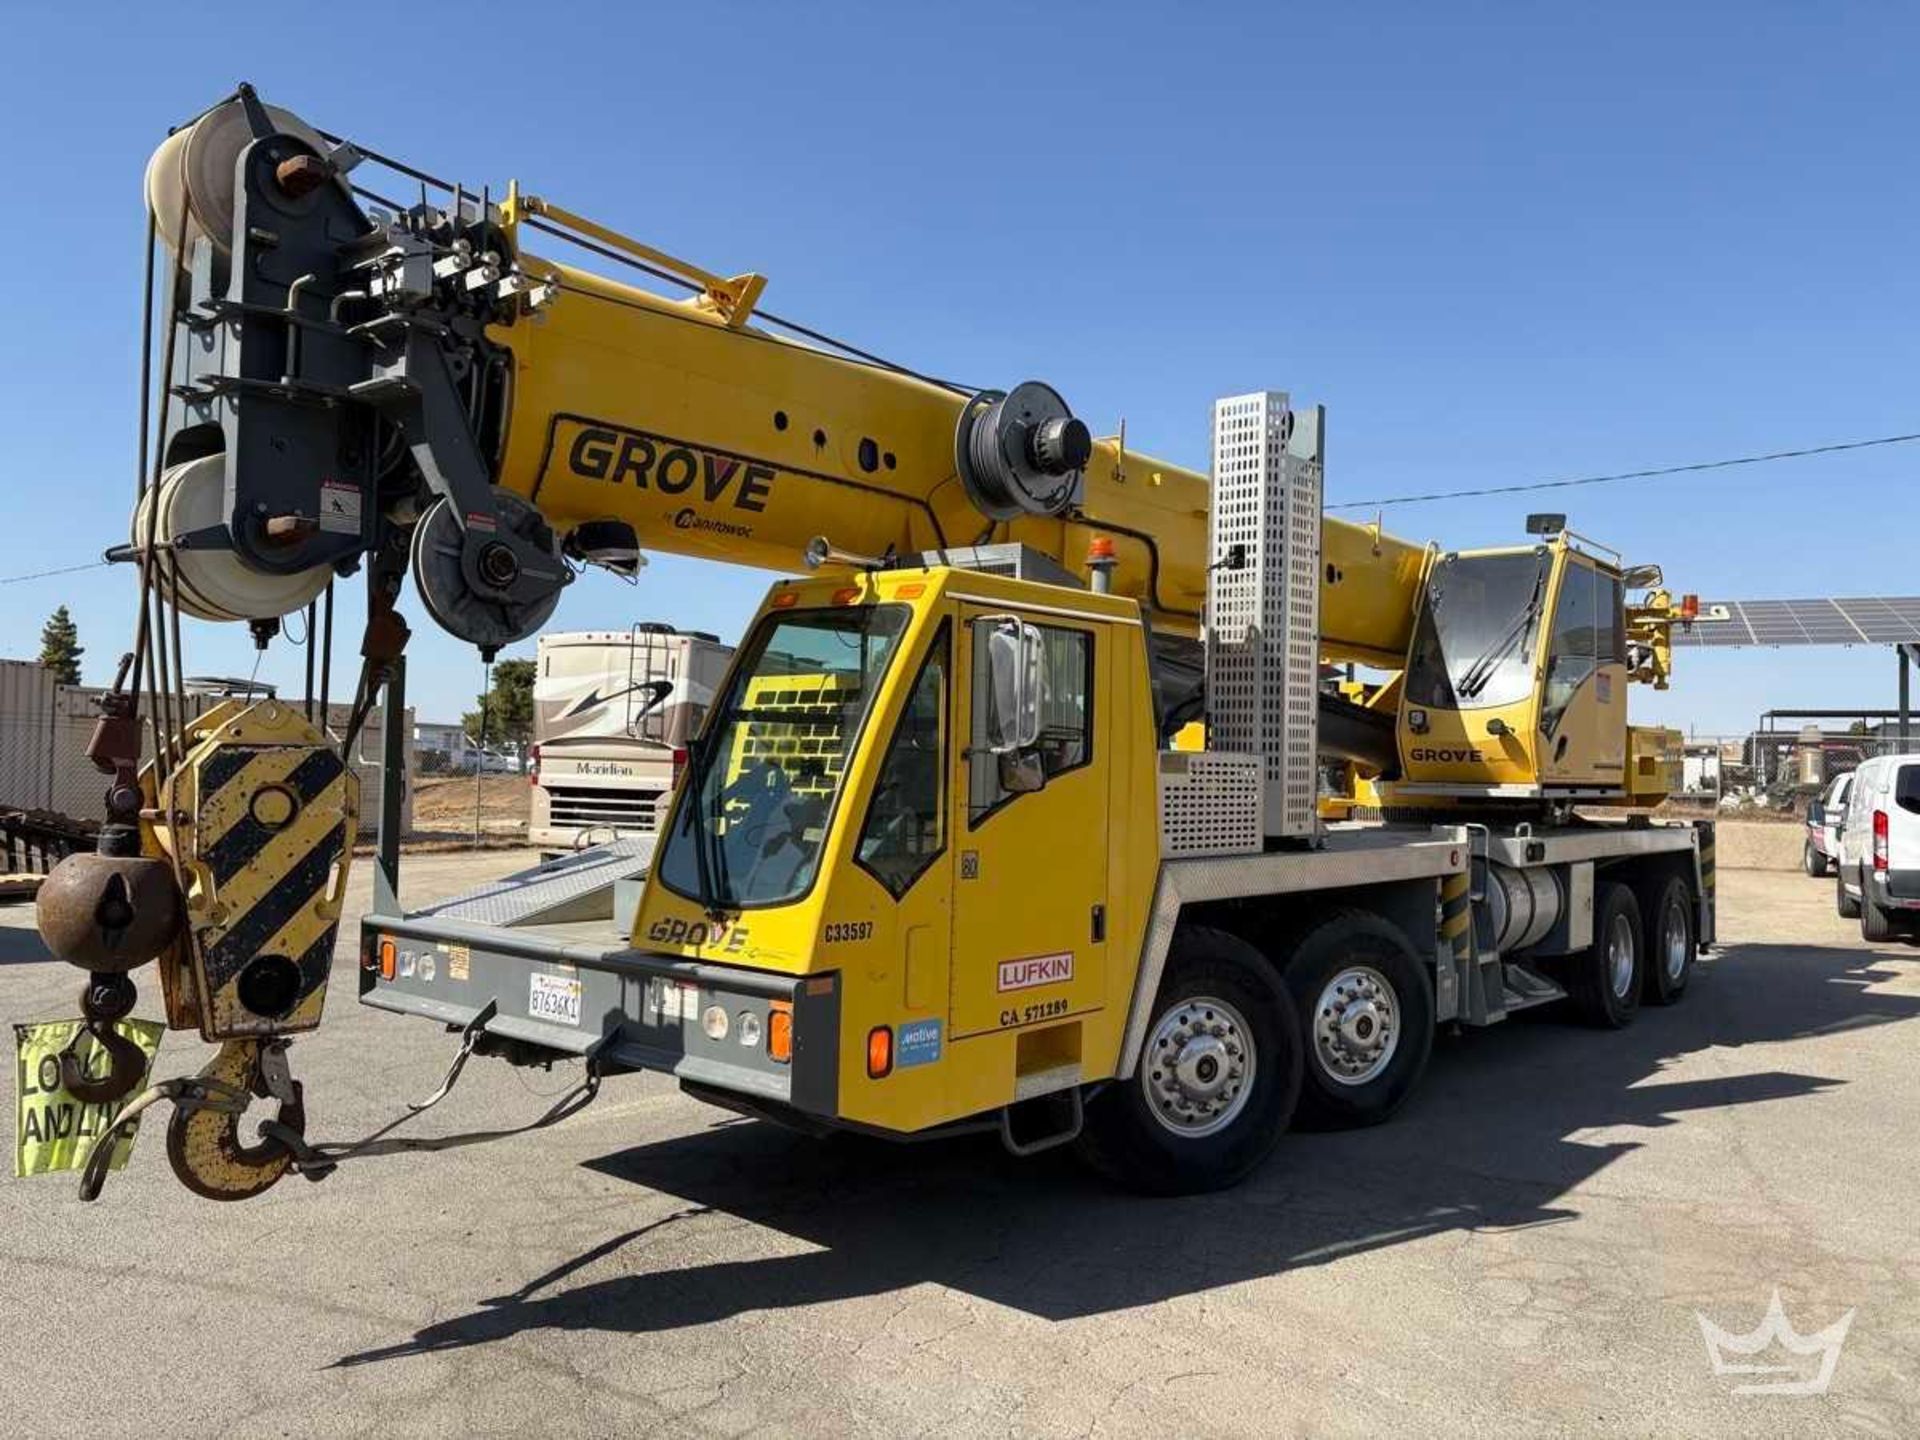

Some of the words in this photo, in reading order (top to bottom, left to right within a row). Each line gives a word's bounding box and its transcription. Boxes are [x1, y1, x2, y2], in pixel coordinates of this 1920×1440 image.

[568, 428, 776, 512] GROVE
[576, 762, 633, 776] Meridian
[1410, 748, 1484, 763] GROVE
[648, 916, 750, 953] GROVE
[825, 921, 873, 943] C33597
[1003, 959, 1070, 986] LUFKIN
[1000, 1008, 1019, 1026] CA
[1025, 998, 1069, 1022] 571289
[22, 1102, 75, 1146] AND
